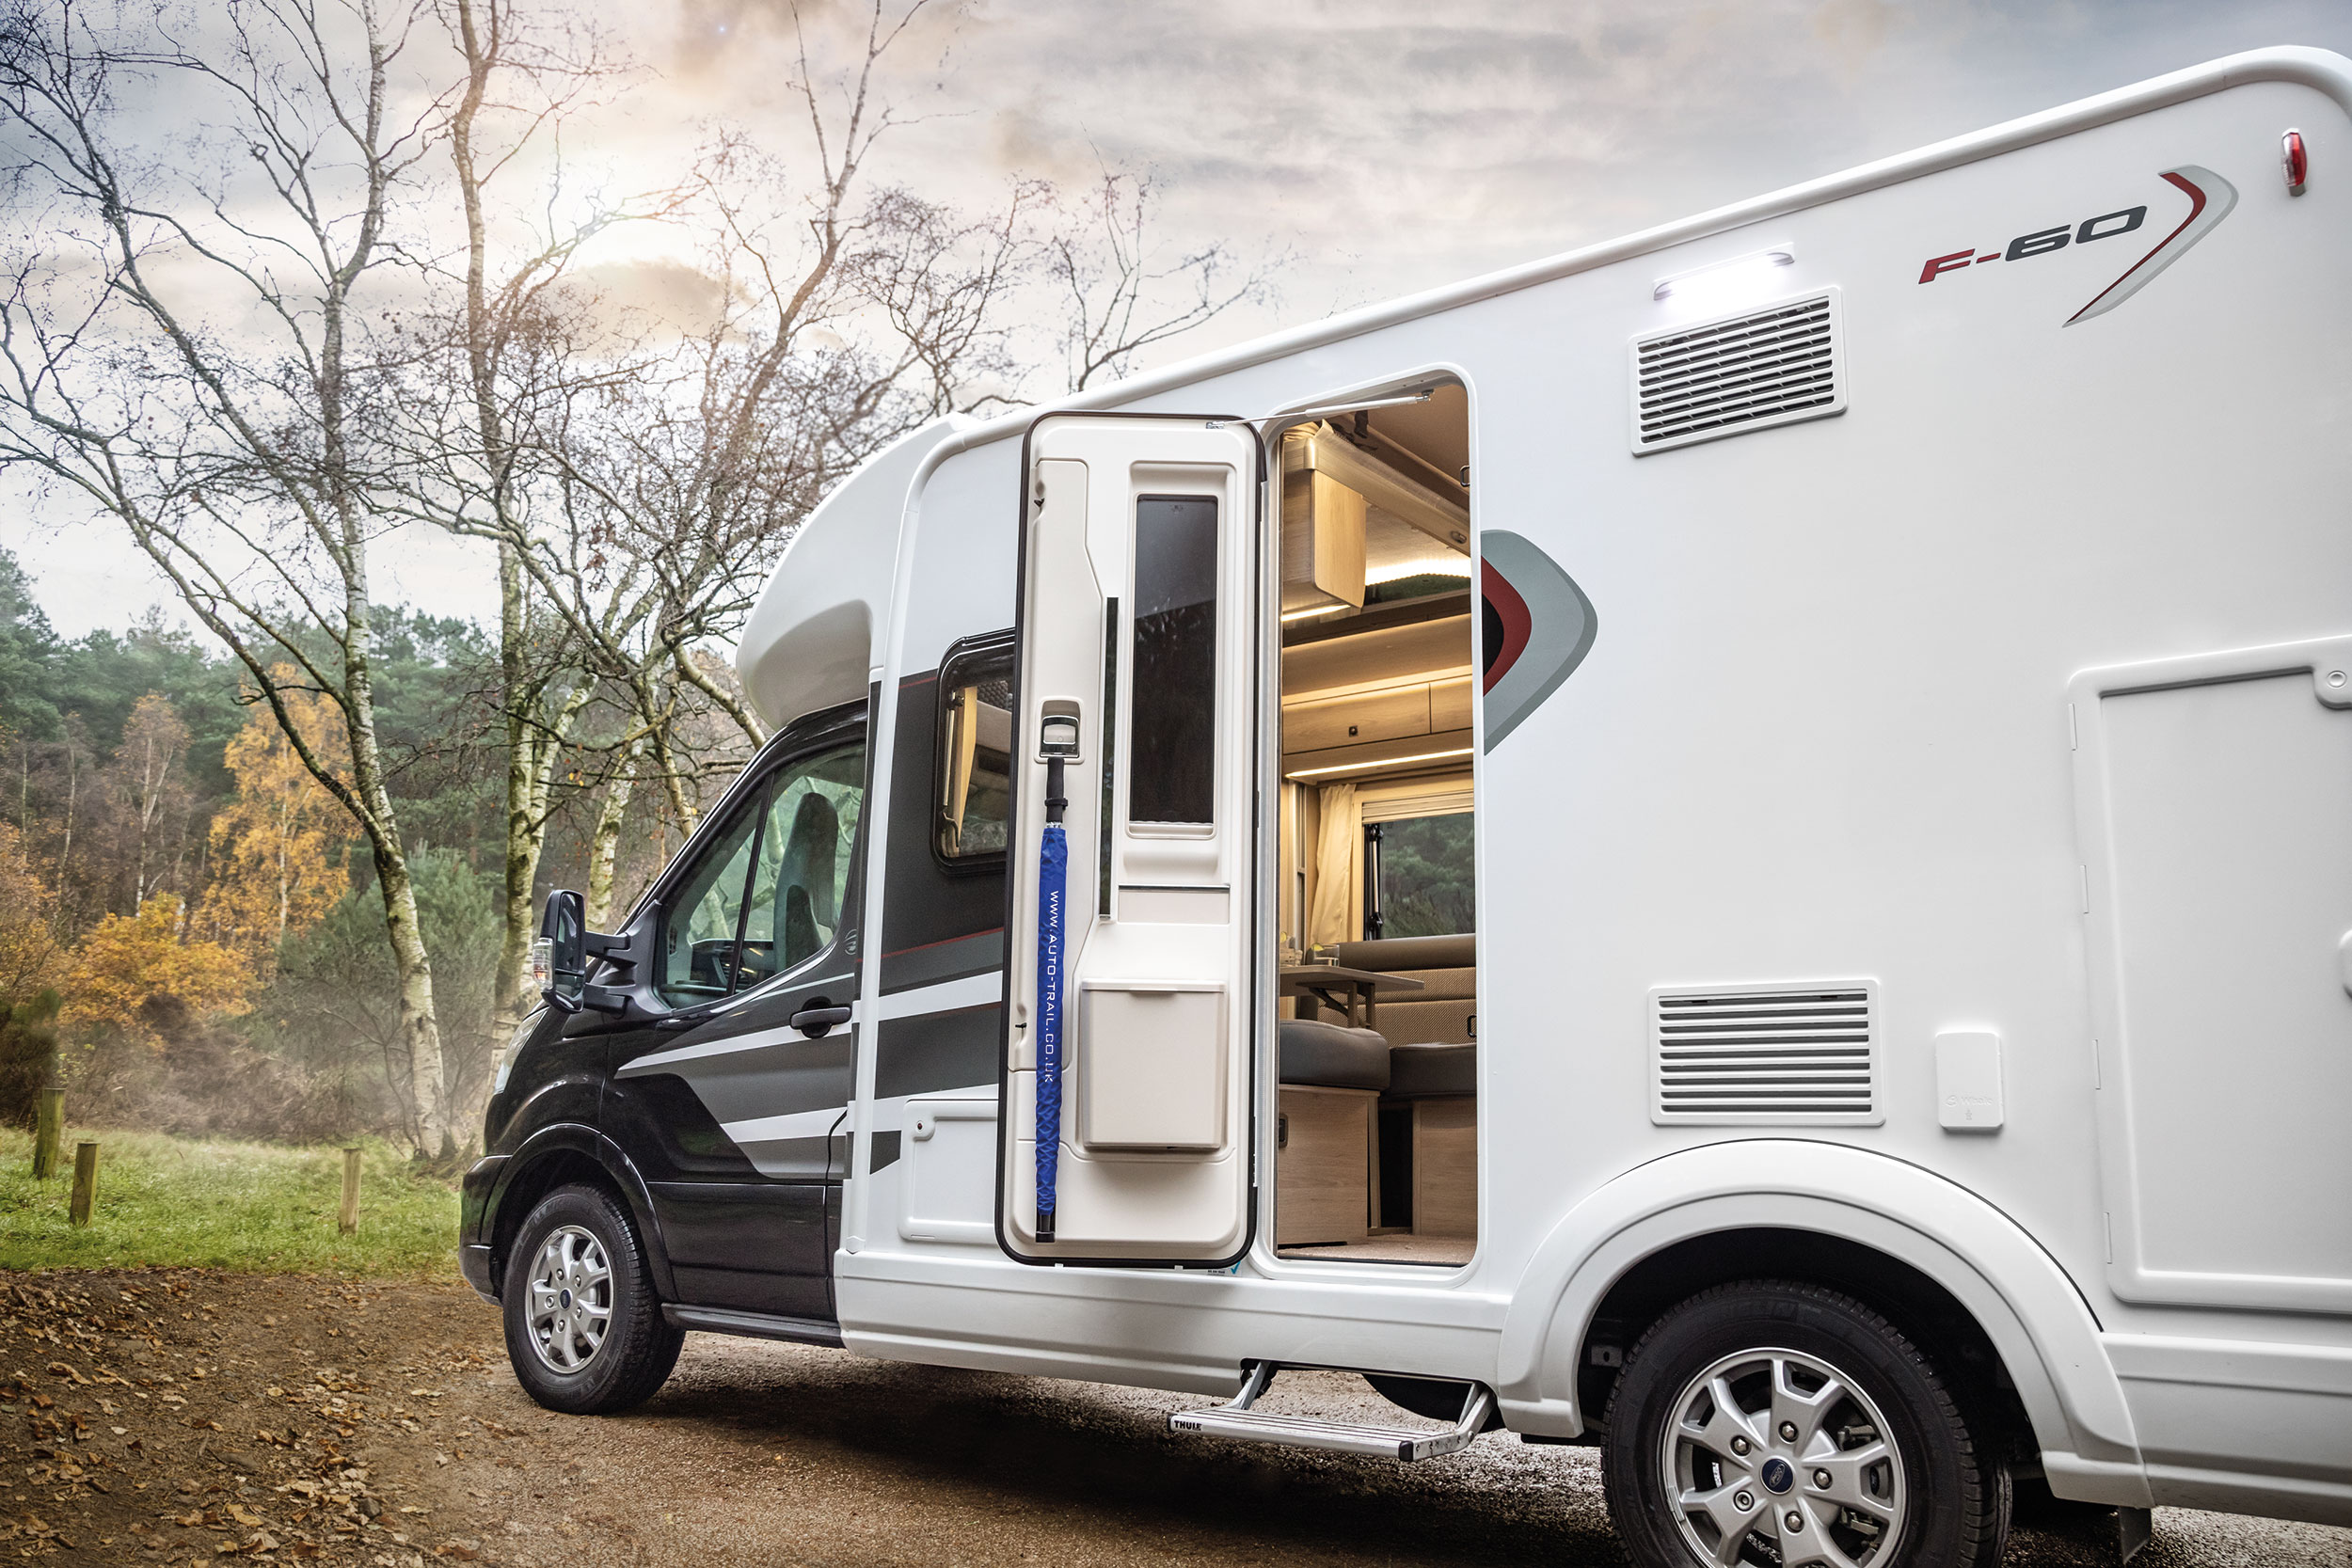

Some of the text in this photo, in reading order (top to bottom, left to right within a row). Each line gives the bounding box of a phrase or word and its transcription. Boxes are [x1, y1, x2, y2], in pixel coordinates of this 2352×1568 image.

[1918, 205, 2148, 285] F-60
[1044, 890, 1059, 1083] WWW.AUTO-TRAIL.CO.UK
[1174, 1420, 1202, 1431] THULE
